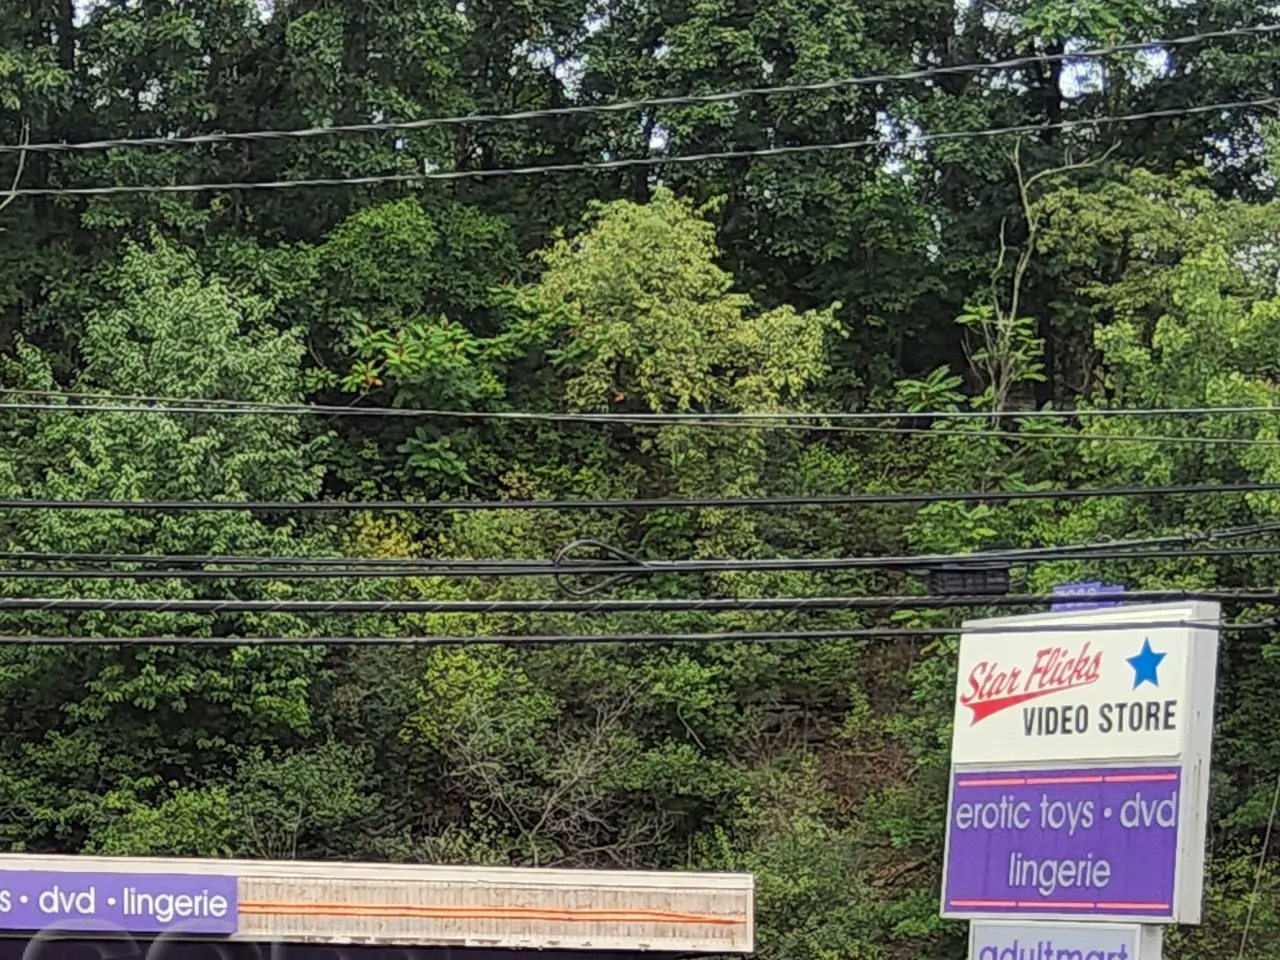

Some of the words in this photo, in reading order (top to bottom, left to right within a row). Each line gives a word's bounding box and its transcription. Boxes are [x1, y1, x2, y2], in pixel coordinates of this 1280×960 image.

[960, 660, 1020, 704] Star
[1023, 641, 1104, 690] Flicks
[1023, 704, 1089, 736] VIDEO
[1099, 700, 1177, 733] STORE
[956, 795, 1031, 829] erotic
[1039, 794, 1093, 836] toys
[1120, 791, 1177, 828] dvd
[1008, 852, 1110, 896] lingerie
[39, 885, 95, 914] dvd
[124, 887, 227, 923] lingerie
